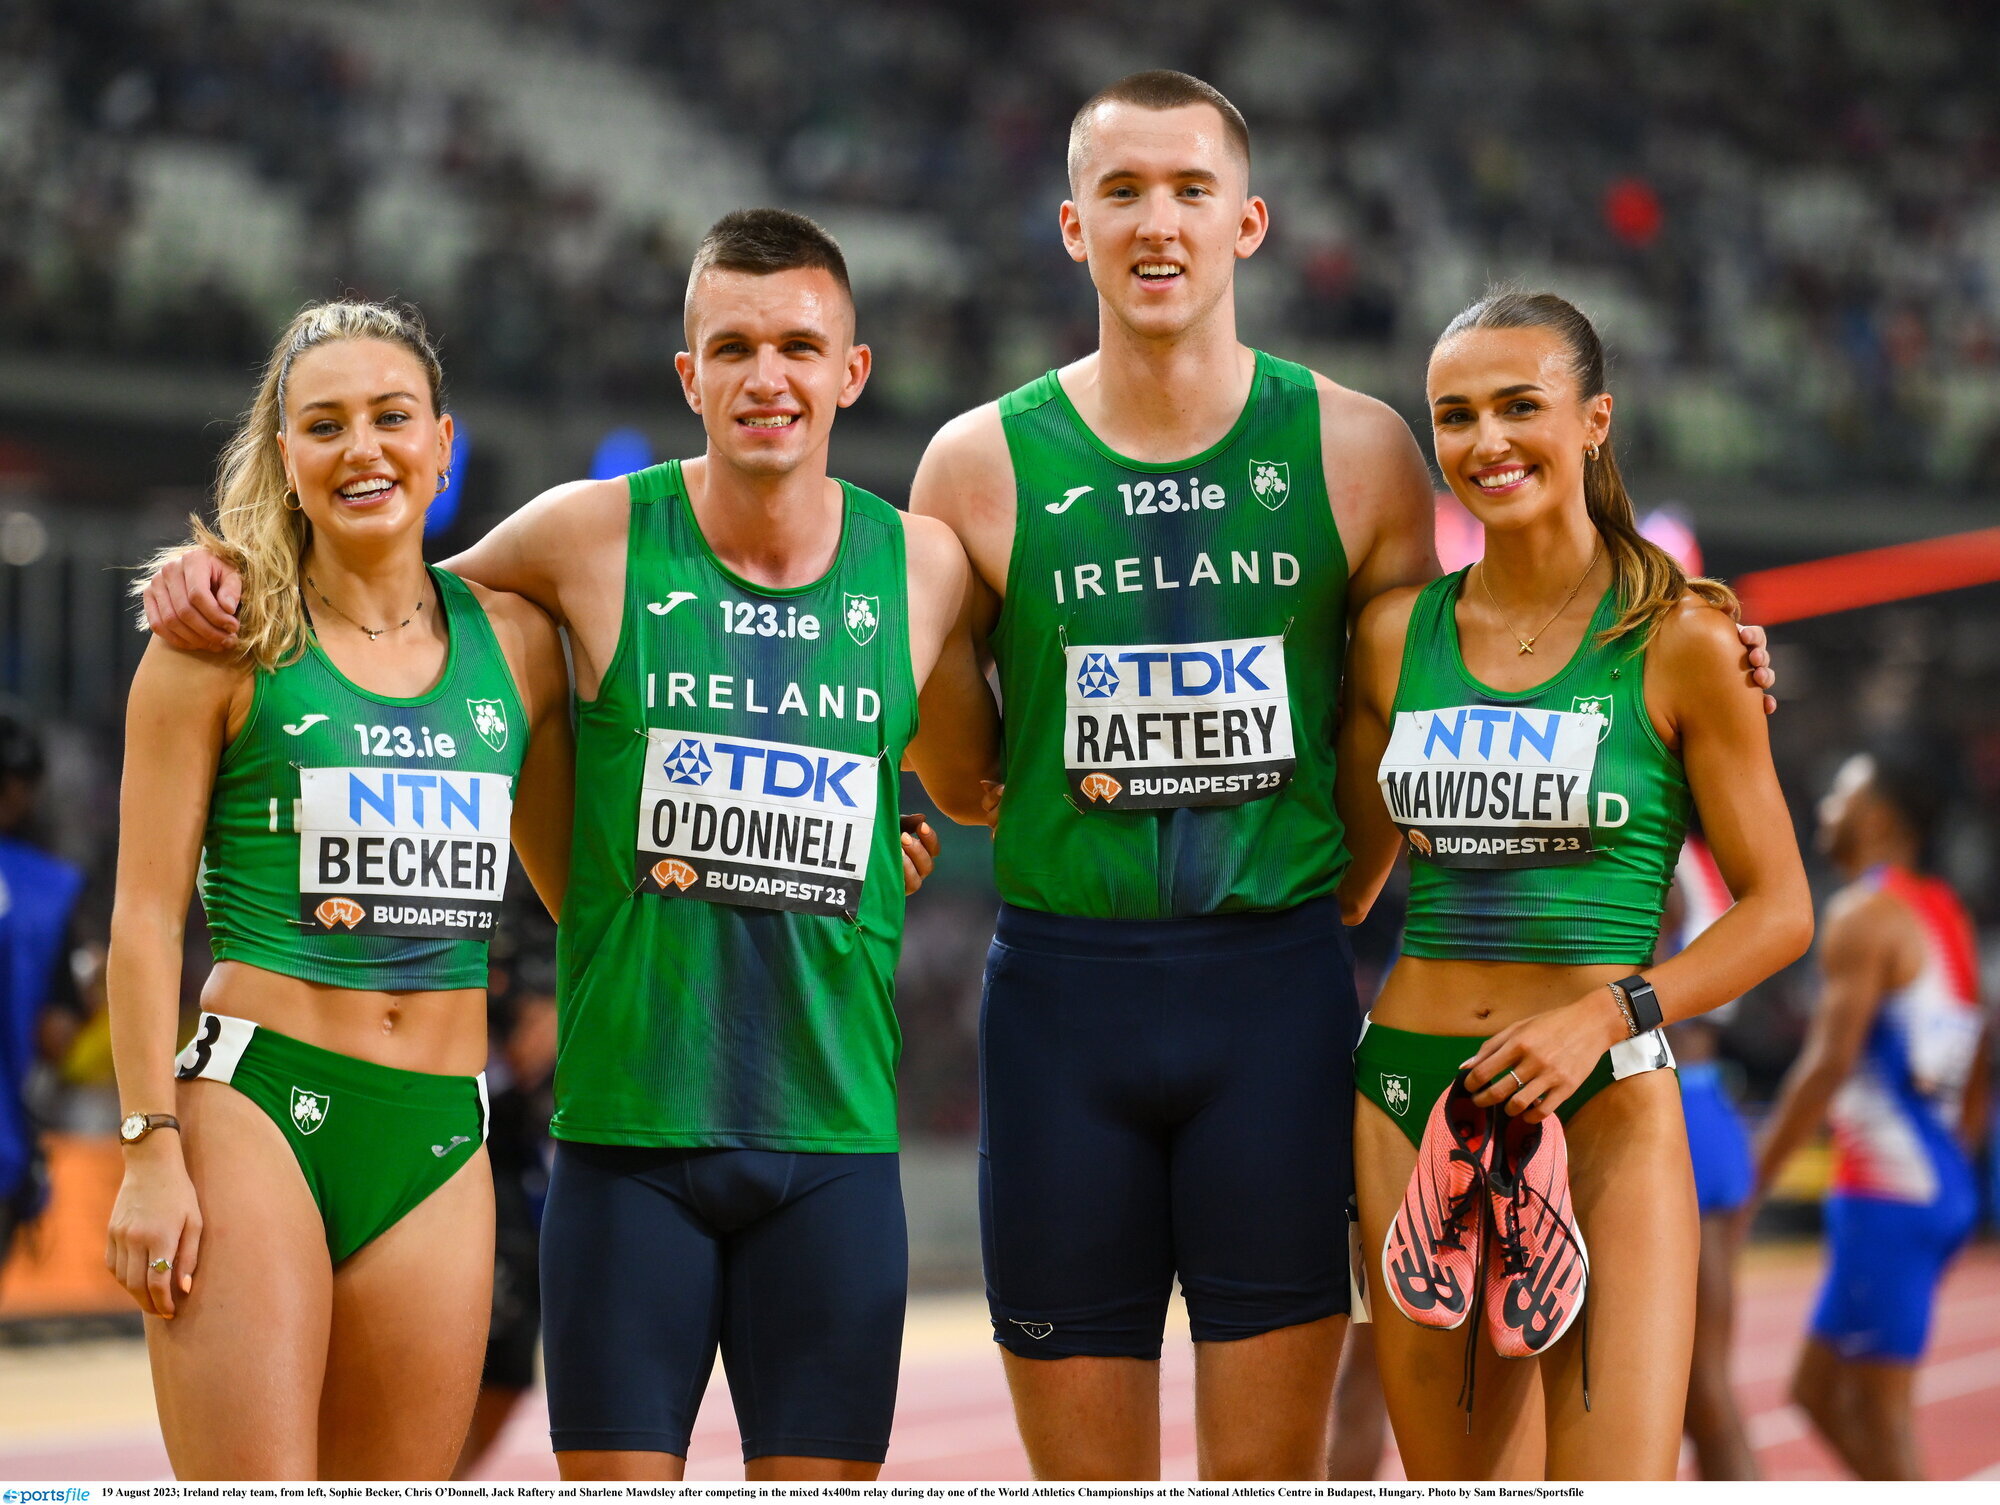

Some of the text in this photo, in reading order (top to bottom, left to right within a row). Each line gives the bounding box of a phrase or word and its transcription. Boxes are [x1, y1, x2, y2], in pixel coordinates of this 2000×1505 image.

[1117, 477, 1226, 516] 123.ie
[1053, 550, 1301, 605] IRELAND
[719, 600, 821, 641] 123.ie
[1118, 644, 1271, 697] TDK
[647, 672, 881, 723] IRELAND
[354, 723, 457, 759] 123.ie
[1077, 704, 1278, 763] RAFTERY
[1423, 709, 1562, 763] NTN
[714, 741, 862, 808] TDK
[1129, 772, 1281, 796] BUDAPEST 23
[1386, 770, 1580, 822] MAWDSLEY
[349, 771, 481, 832] NTN
[652, 798, 857, 873] O'DONNELL
[1435, 836, 1580, 856] BUDAPEST 23
[318, 836, 497, 892] BECKER
[706, 870, 847, 906] BUDAPEST 23
[373, 905, 493, 929] BUDAPEST 23
[177, 1015, 222, 1080] 3
